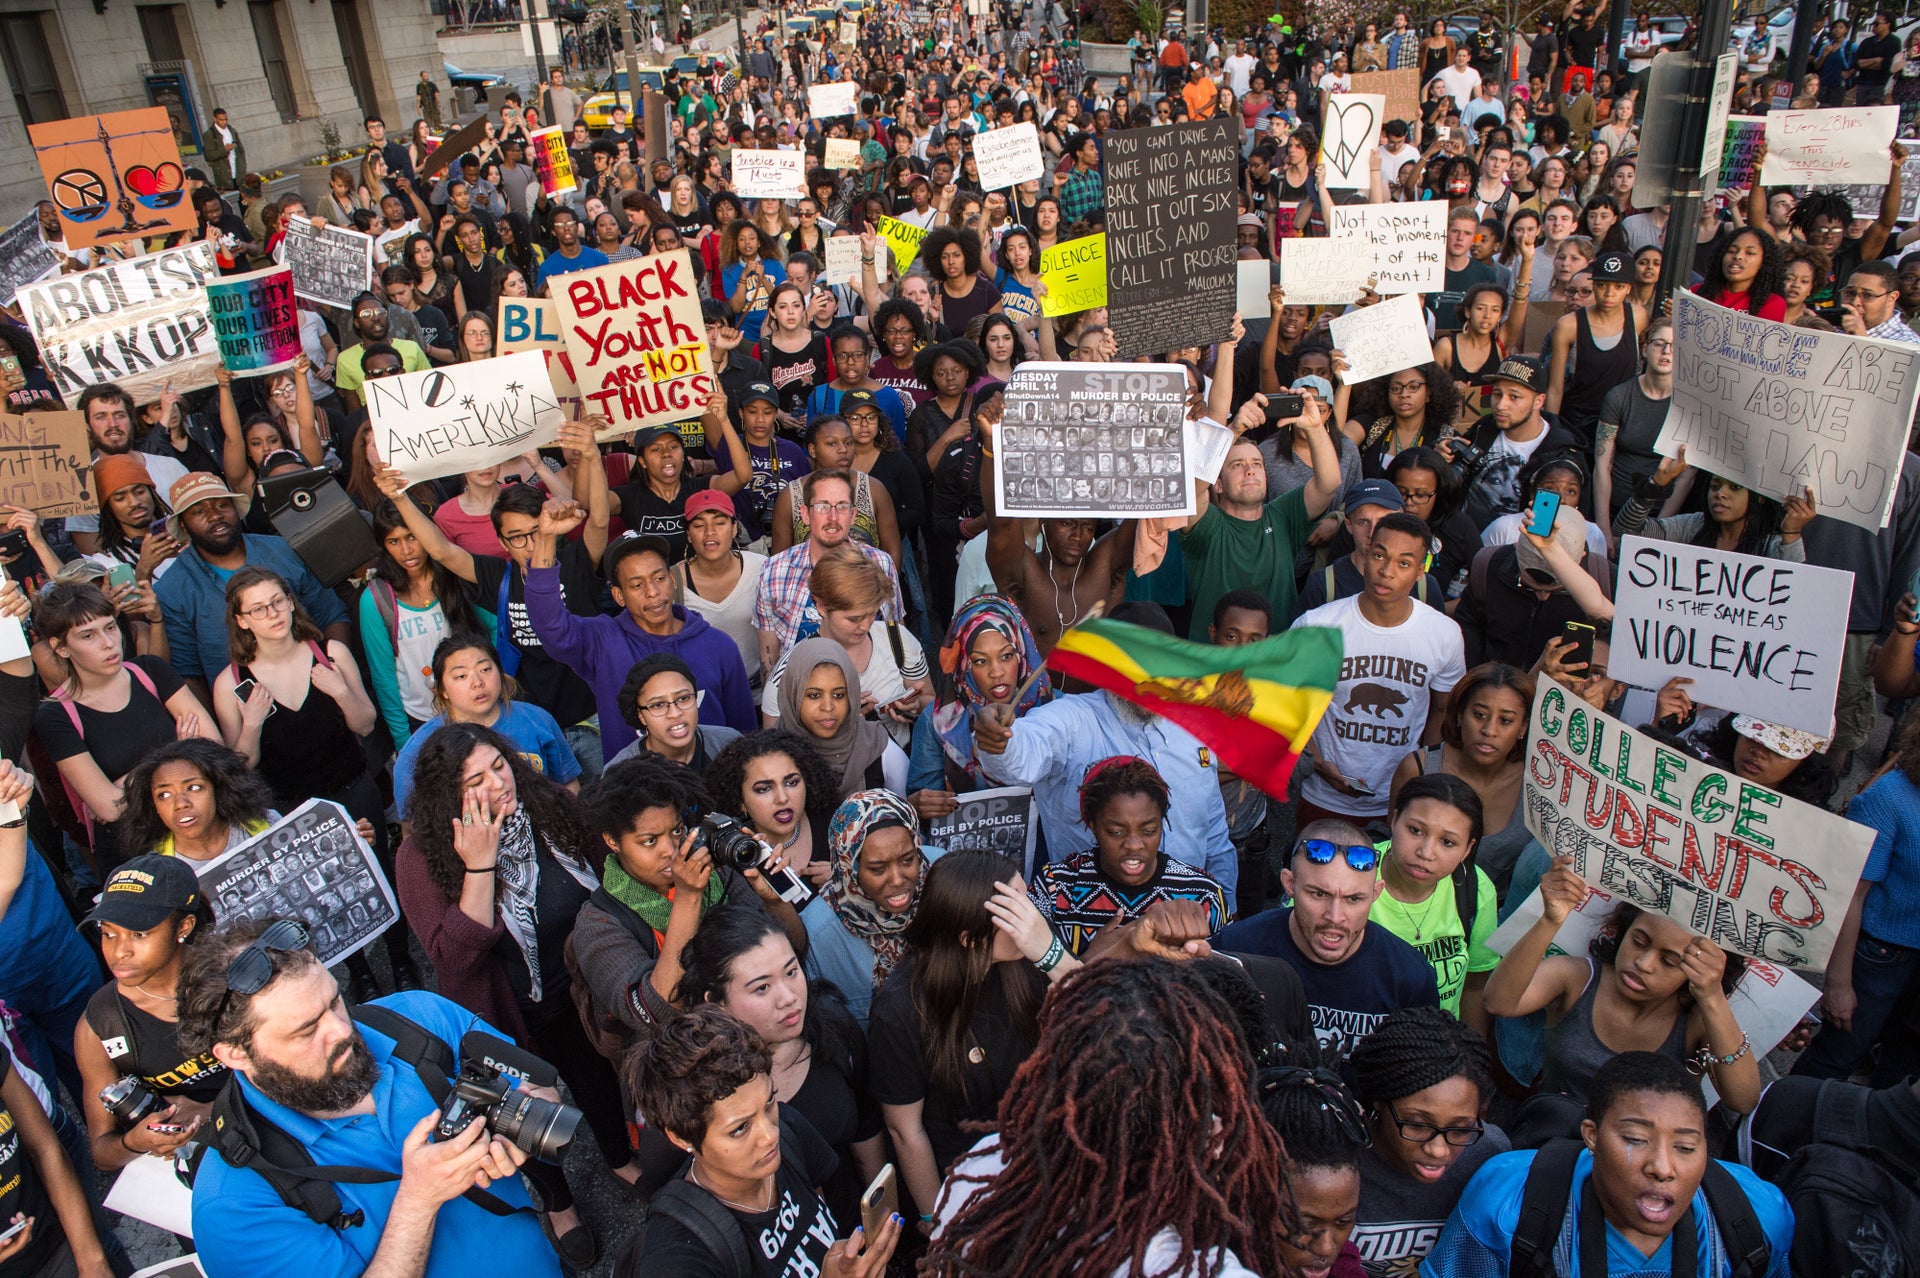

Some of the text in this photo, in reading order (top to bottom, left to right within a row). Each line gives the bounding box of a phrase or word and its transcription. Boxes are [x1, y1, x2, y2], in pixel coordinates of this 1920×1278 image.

[1356, 69, 1418, 89] JUSTICE
[1776, 84, 1789, 97] NO
[546, 136, 563, 150] CITY
[1179, 128, 1208, 146] DRIVE
[1213, 124, 1227, 142] A
[735, 153, 775, 167] Justice
[1107, 159, 1142, 182] KNIFE
[1149, 152, 1178, 174] INTO
[1184, 150, 1196, 170] A
[1107, 183, 1139, 208] BACK
[1147, 175, 1179, 200] NINE
[1107, 190, 1232, 233] PULL IT OUT SIX
[1334, 209, 1429, 234] Not apart
[1175, 221, 1209, 247] AND
[1396, 229, 1448, 245] moment
[1041, 243, 1102, 274] SILENCE
[1388, 250, 1403, 264] of
[1418, 250, 1439, 263] the
[568, 258, 688, 319] BLACK
[1110, 264, 1152, 290] CALL
[1160, 257, 1175, 280] IT
[1227, 273, 1236, 286] X
[212, 281, 289, 315] OUR CITY
[217, 304, 291, 336] OUR LIVES
[573, 304, 698, 366] Youth
[220, 323, 299, 357] OUR FREEDOM
[1679, 298, 1914, 404] POLICE ARE
[601, 362, 645, 389] ARE
[644, 344, 705, 383] NOT
[772, 358, 816, 384] Maryland
[1005, 382, 1057, 391] APRIL 14
[1007, 373, 1169, 394] TUESDAY STOP
[1070, 392, 1181, 402] MURDER BY POLICE
[1678, 347, 1854, 443] NOT ABOVE
[39, 448, 81, 474] the
[1671, 388, 1750, 474] THE
[1759, 429, 1886, 515] LAW
[1108, 501, 1185, 511] www.revcom.us
[1628, 547, 1793, 606] SILENCE
[1658, 598, 1788, 630] IS THE SAME AS
[1629, 617, 1818, 691] VIOLENCE
[1338, 655, 1429, 688] BRUINS
[1334, 718, 1410, 747] SOCCER
[1540, 687, 1782, 850] COLLEGE
[959, 822, 974, 832] BY
[979, 814, 1022, 828] POLICE
[1531, 739, 1827, 929] STUDENTS
[215, 817, 339, 893] MURDER BY POLICE
[225, 812, 318, 876] STOP
[1526, 783, 1808, 967] PROTESTING
